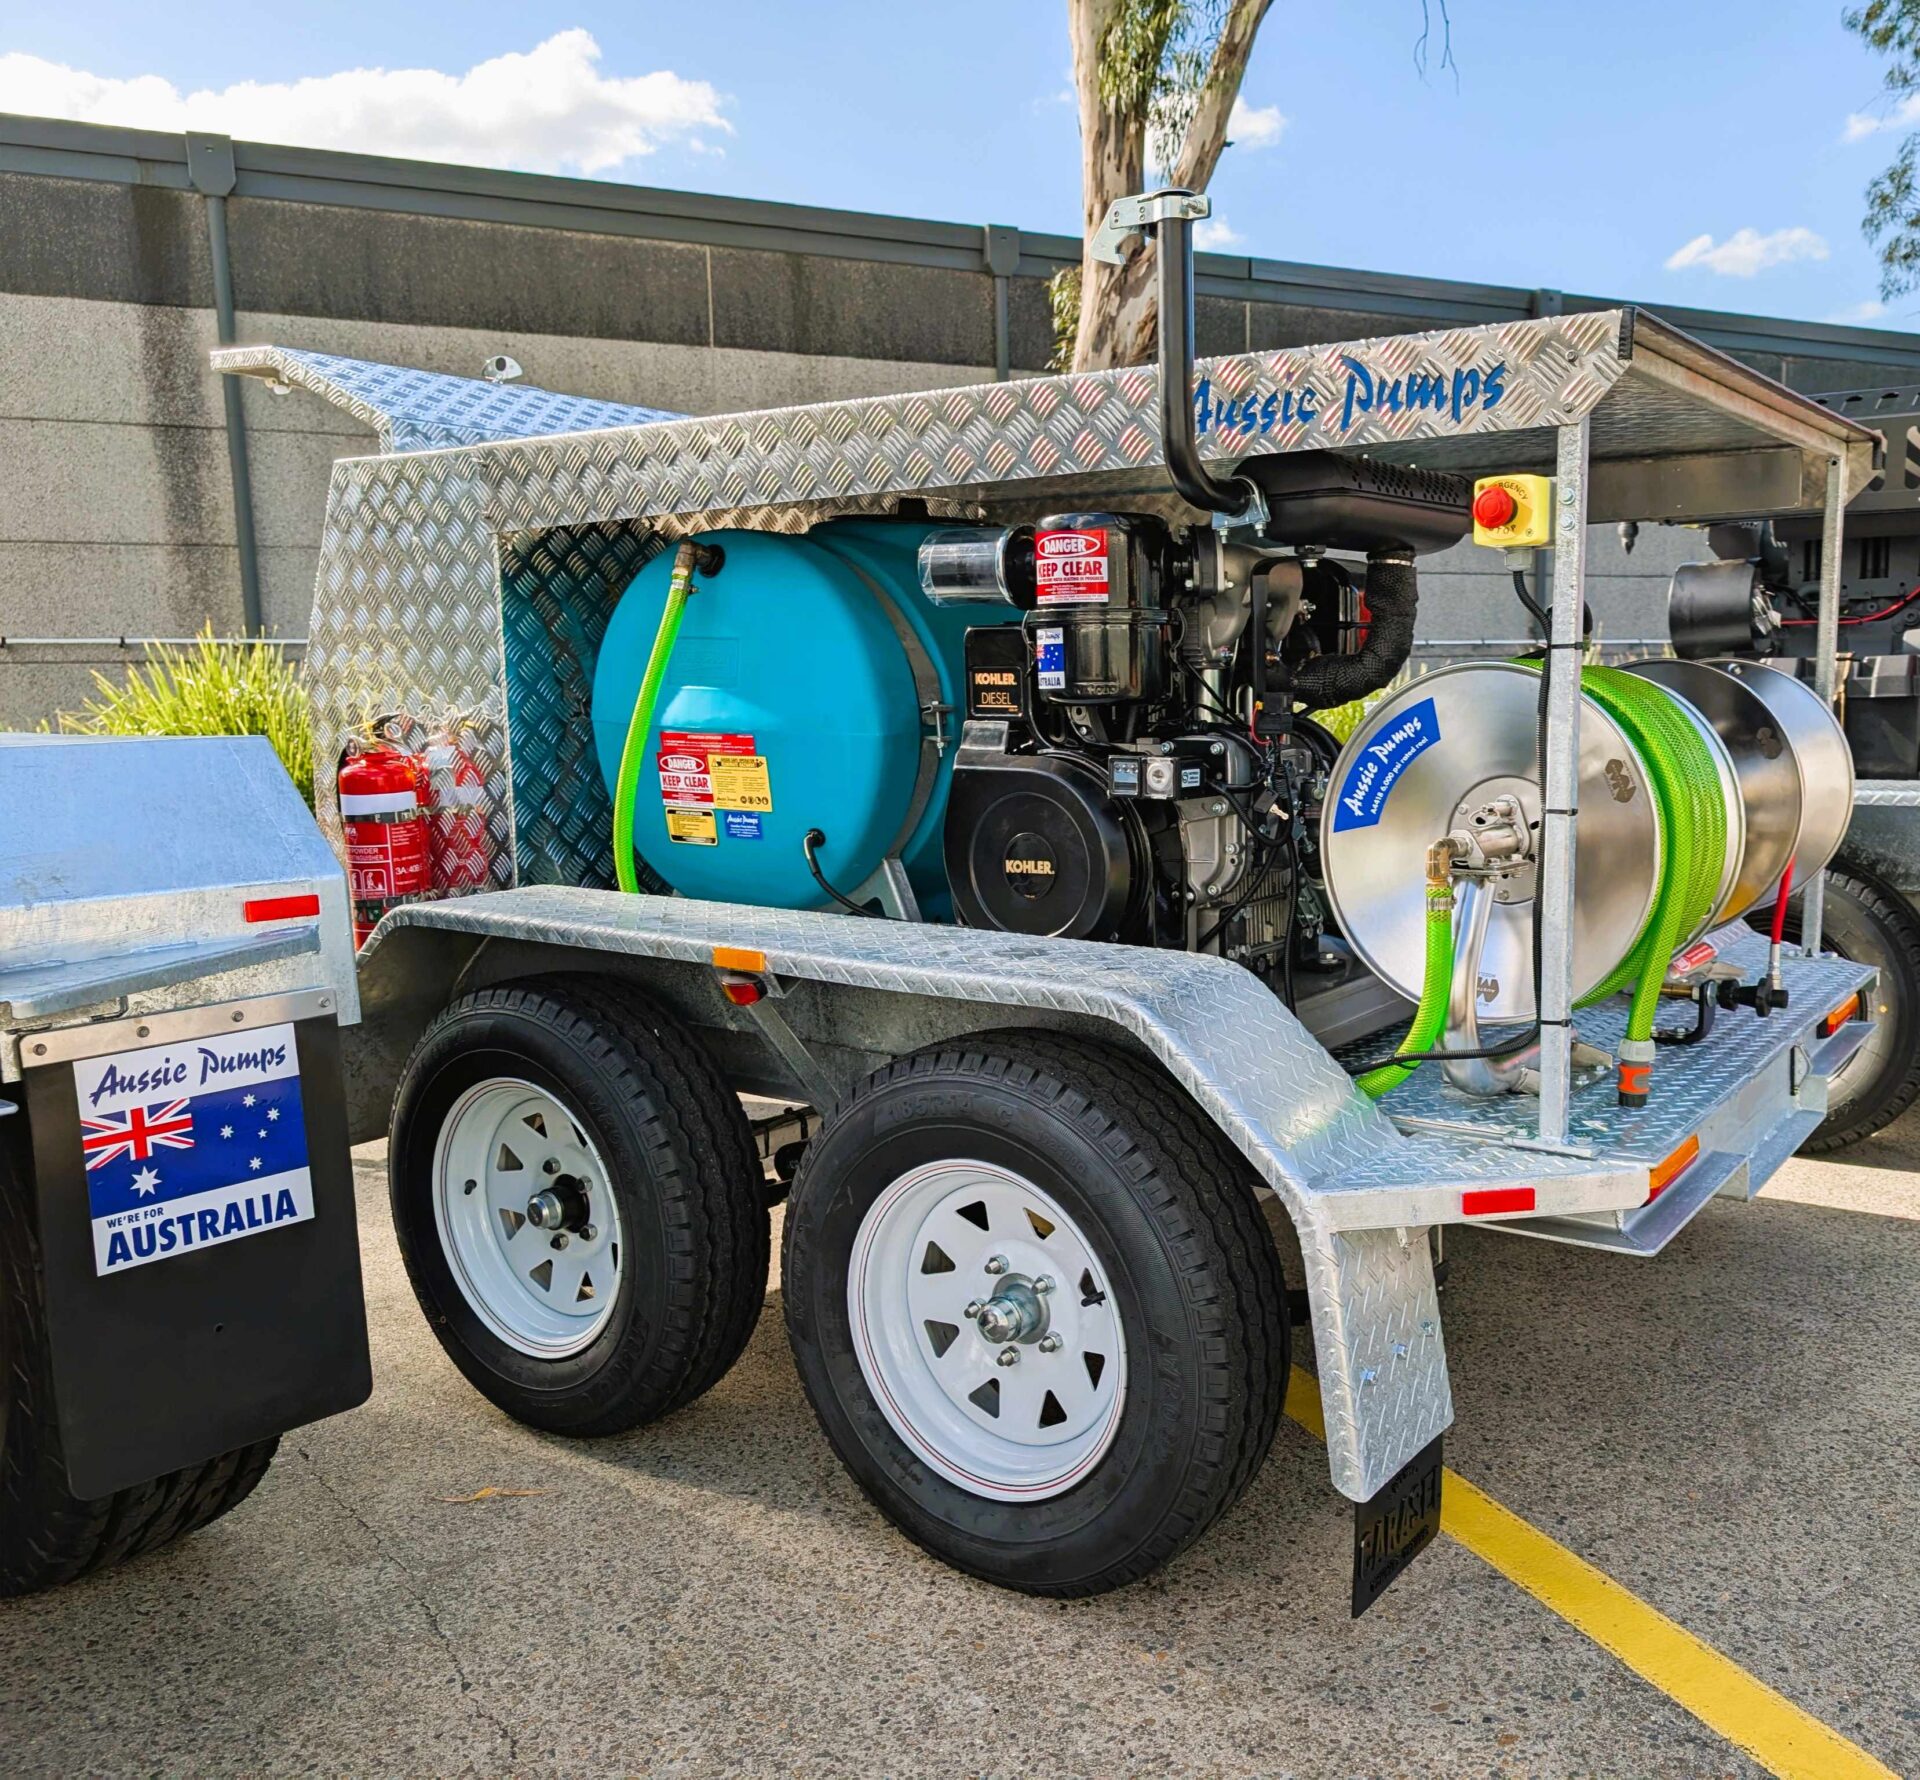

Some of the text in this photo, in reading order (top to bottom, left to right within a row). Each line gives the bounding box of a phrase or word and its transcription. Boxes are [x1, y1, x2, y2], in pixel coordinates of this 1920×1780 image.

[1193, 354, 1506, 435] Aussie Pumps
[1488, 524, 1517, 535] TOP
[1044, 538, 1086, 554] DANGER
[1062, 560, 1102, 576] CLEAR
[981, 691, 1011, 705] DIESEL
[1400, 745, 1417, 764] rated
[667, 758, 697, 770] DANGER
[1343, 716, 1422, 817] Aussie Pumps
[661, 774, 681, 787] KEEP
[684, 776, 709, 788] CLEAR
[89, 1043, 286, 1108] Aussie Pumps
[106, 1206, 164, 1229] WE'RE FOR
[106, 1187, 298, 1267] AUSTRALIA
